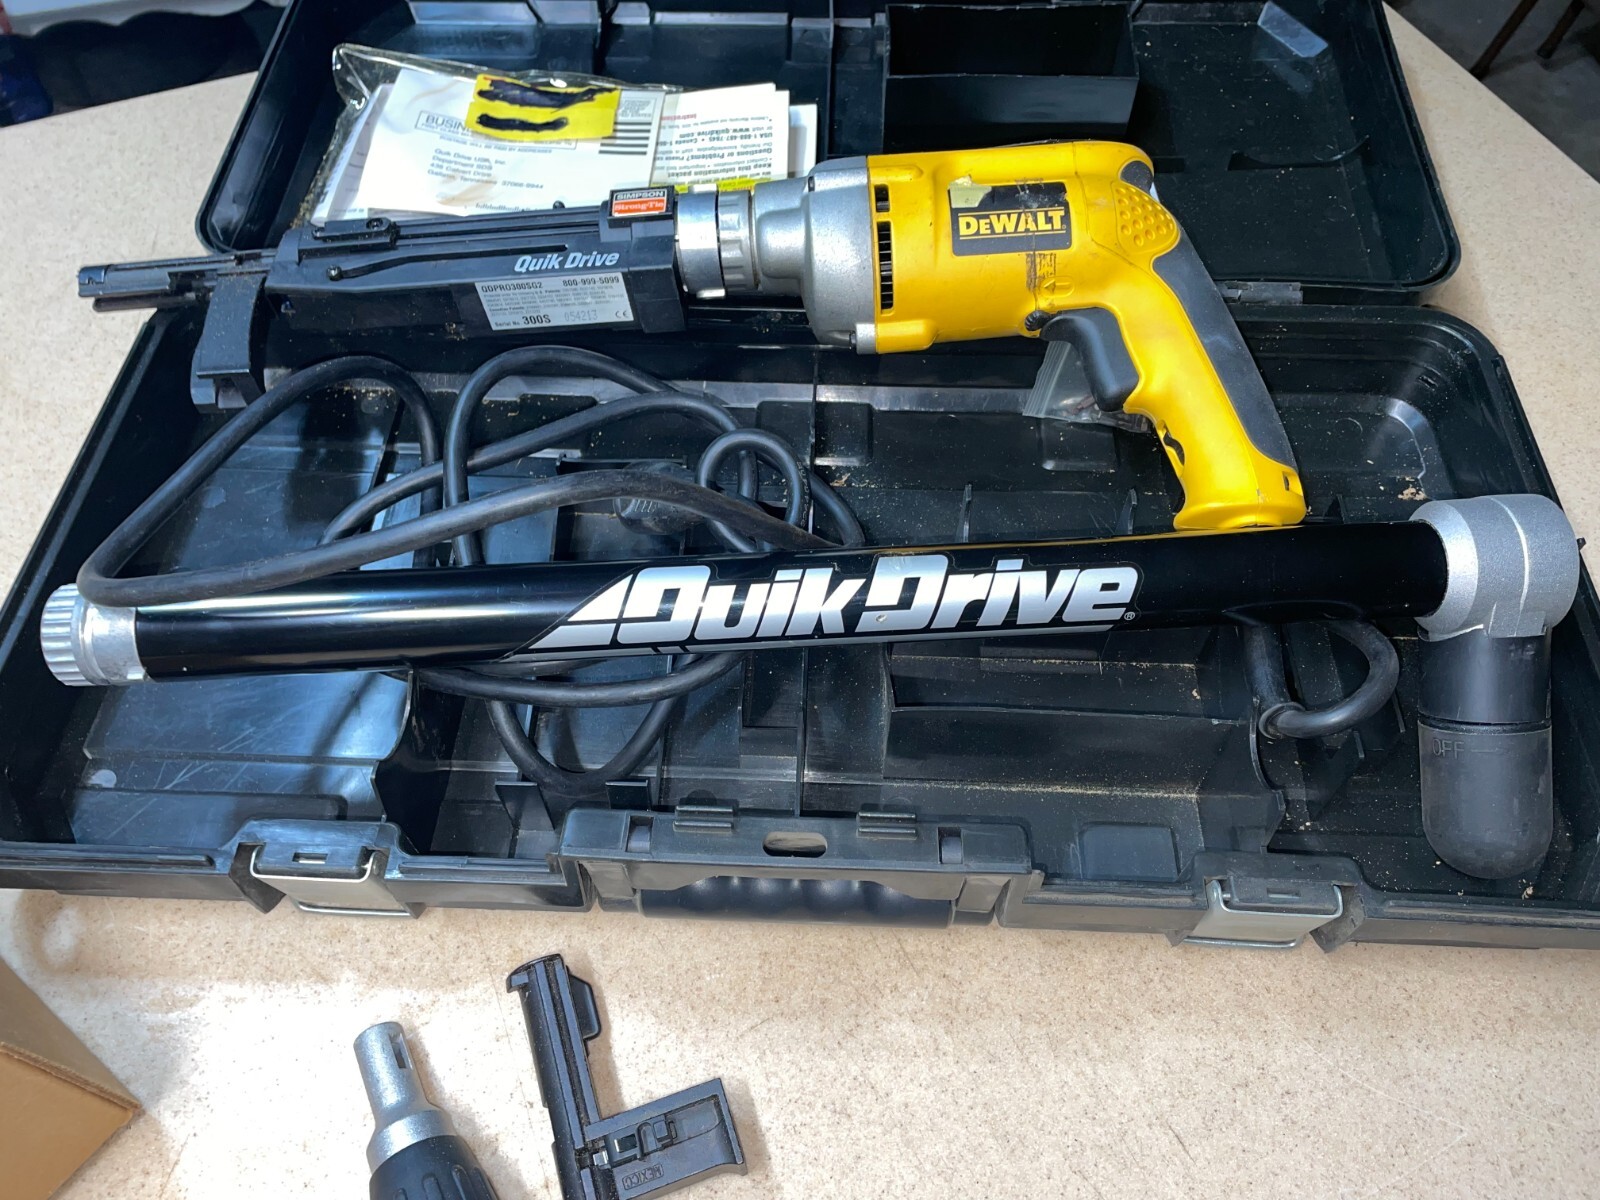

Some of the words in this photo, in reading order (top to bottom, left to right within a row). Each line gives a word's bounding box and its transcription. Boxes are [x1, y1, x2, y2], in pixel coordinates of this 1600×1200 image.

[425, 114, 470, 132] BUSIN
[679, 128, 750, 139] www.quikdrive.com
[454, 152, 472, 161] Drive
[686, 152, 724, 161] Problems?
[737, 148, 772, 157] Questions
[694, 167, 735, 176] information
[616, 190, 663, 200] SIMPSON
[514, 252, 564, 273] Quik
[564, 251, 620, 269] Drive
[562, 276, 620, 287] 800-999-5099
[522, 314, 552, 326] 300S
[564, 309, 598, 322] 054213
[1432, 738, 1466, 760] OFF
[624, 1165, 662, 1190] MEXICO
